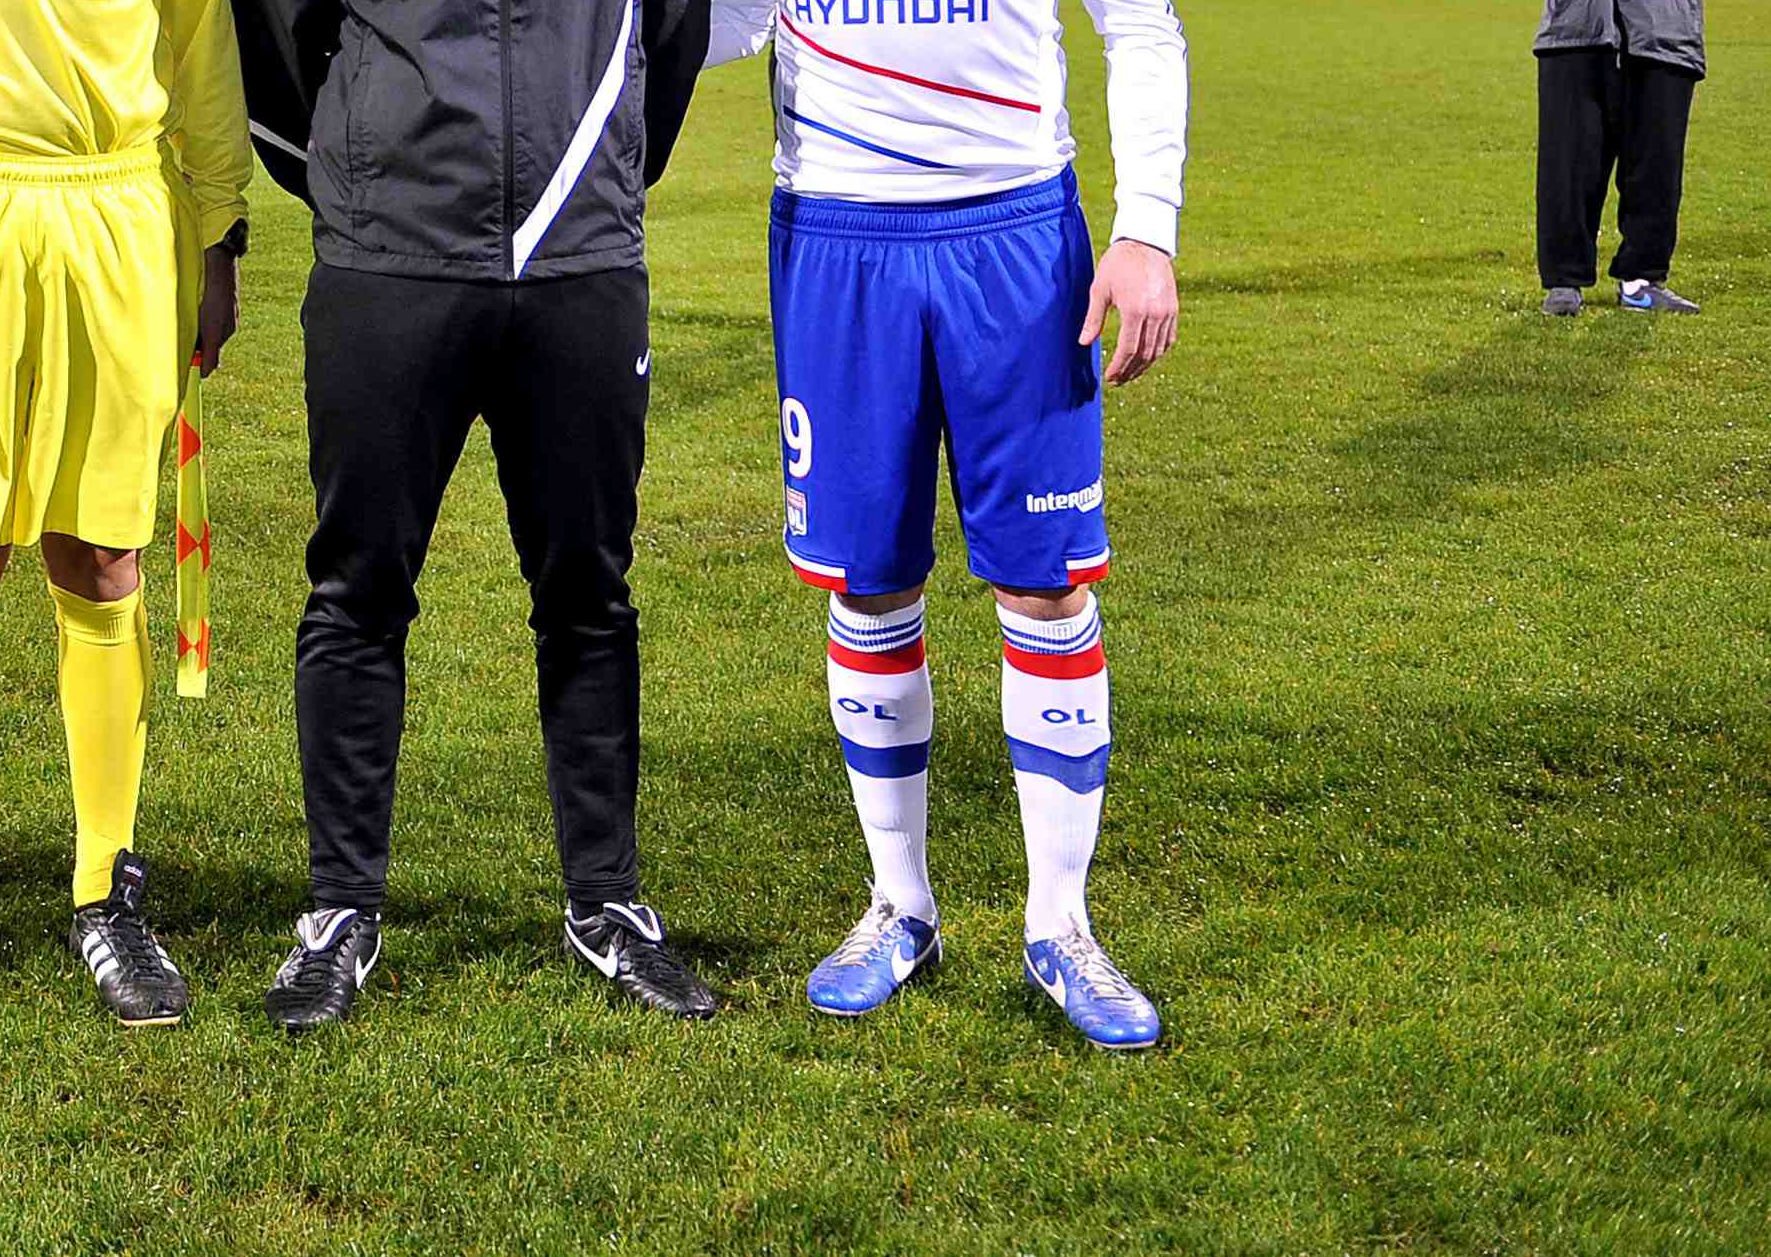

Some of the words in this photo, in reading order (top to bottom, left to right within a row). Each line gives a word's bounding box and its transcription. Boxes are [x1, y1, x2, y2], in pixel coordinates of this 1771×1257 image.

[781, 397, 813, 478] 9
[837, 697, 897, 722] OL
[1041, 707, 1097, 726] OL
